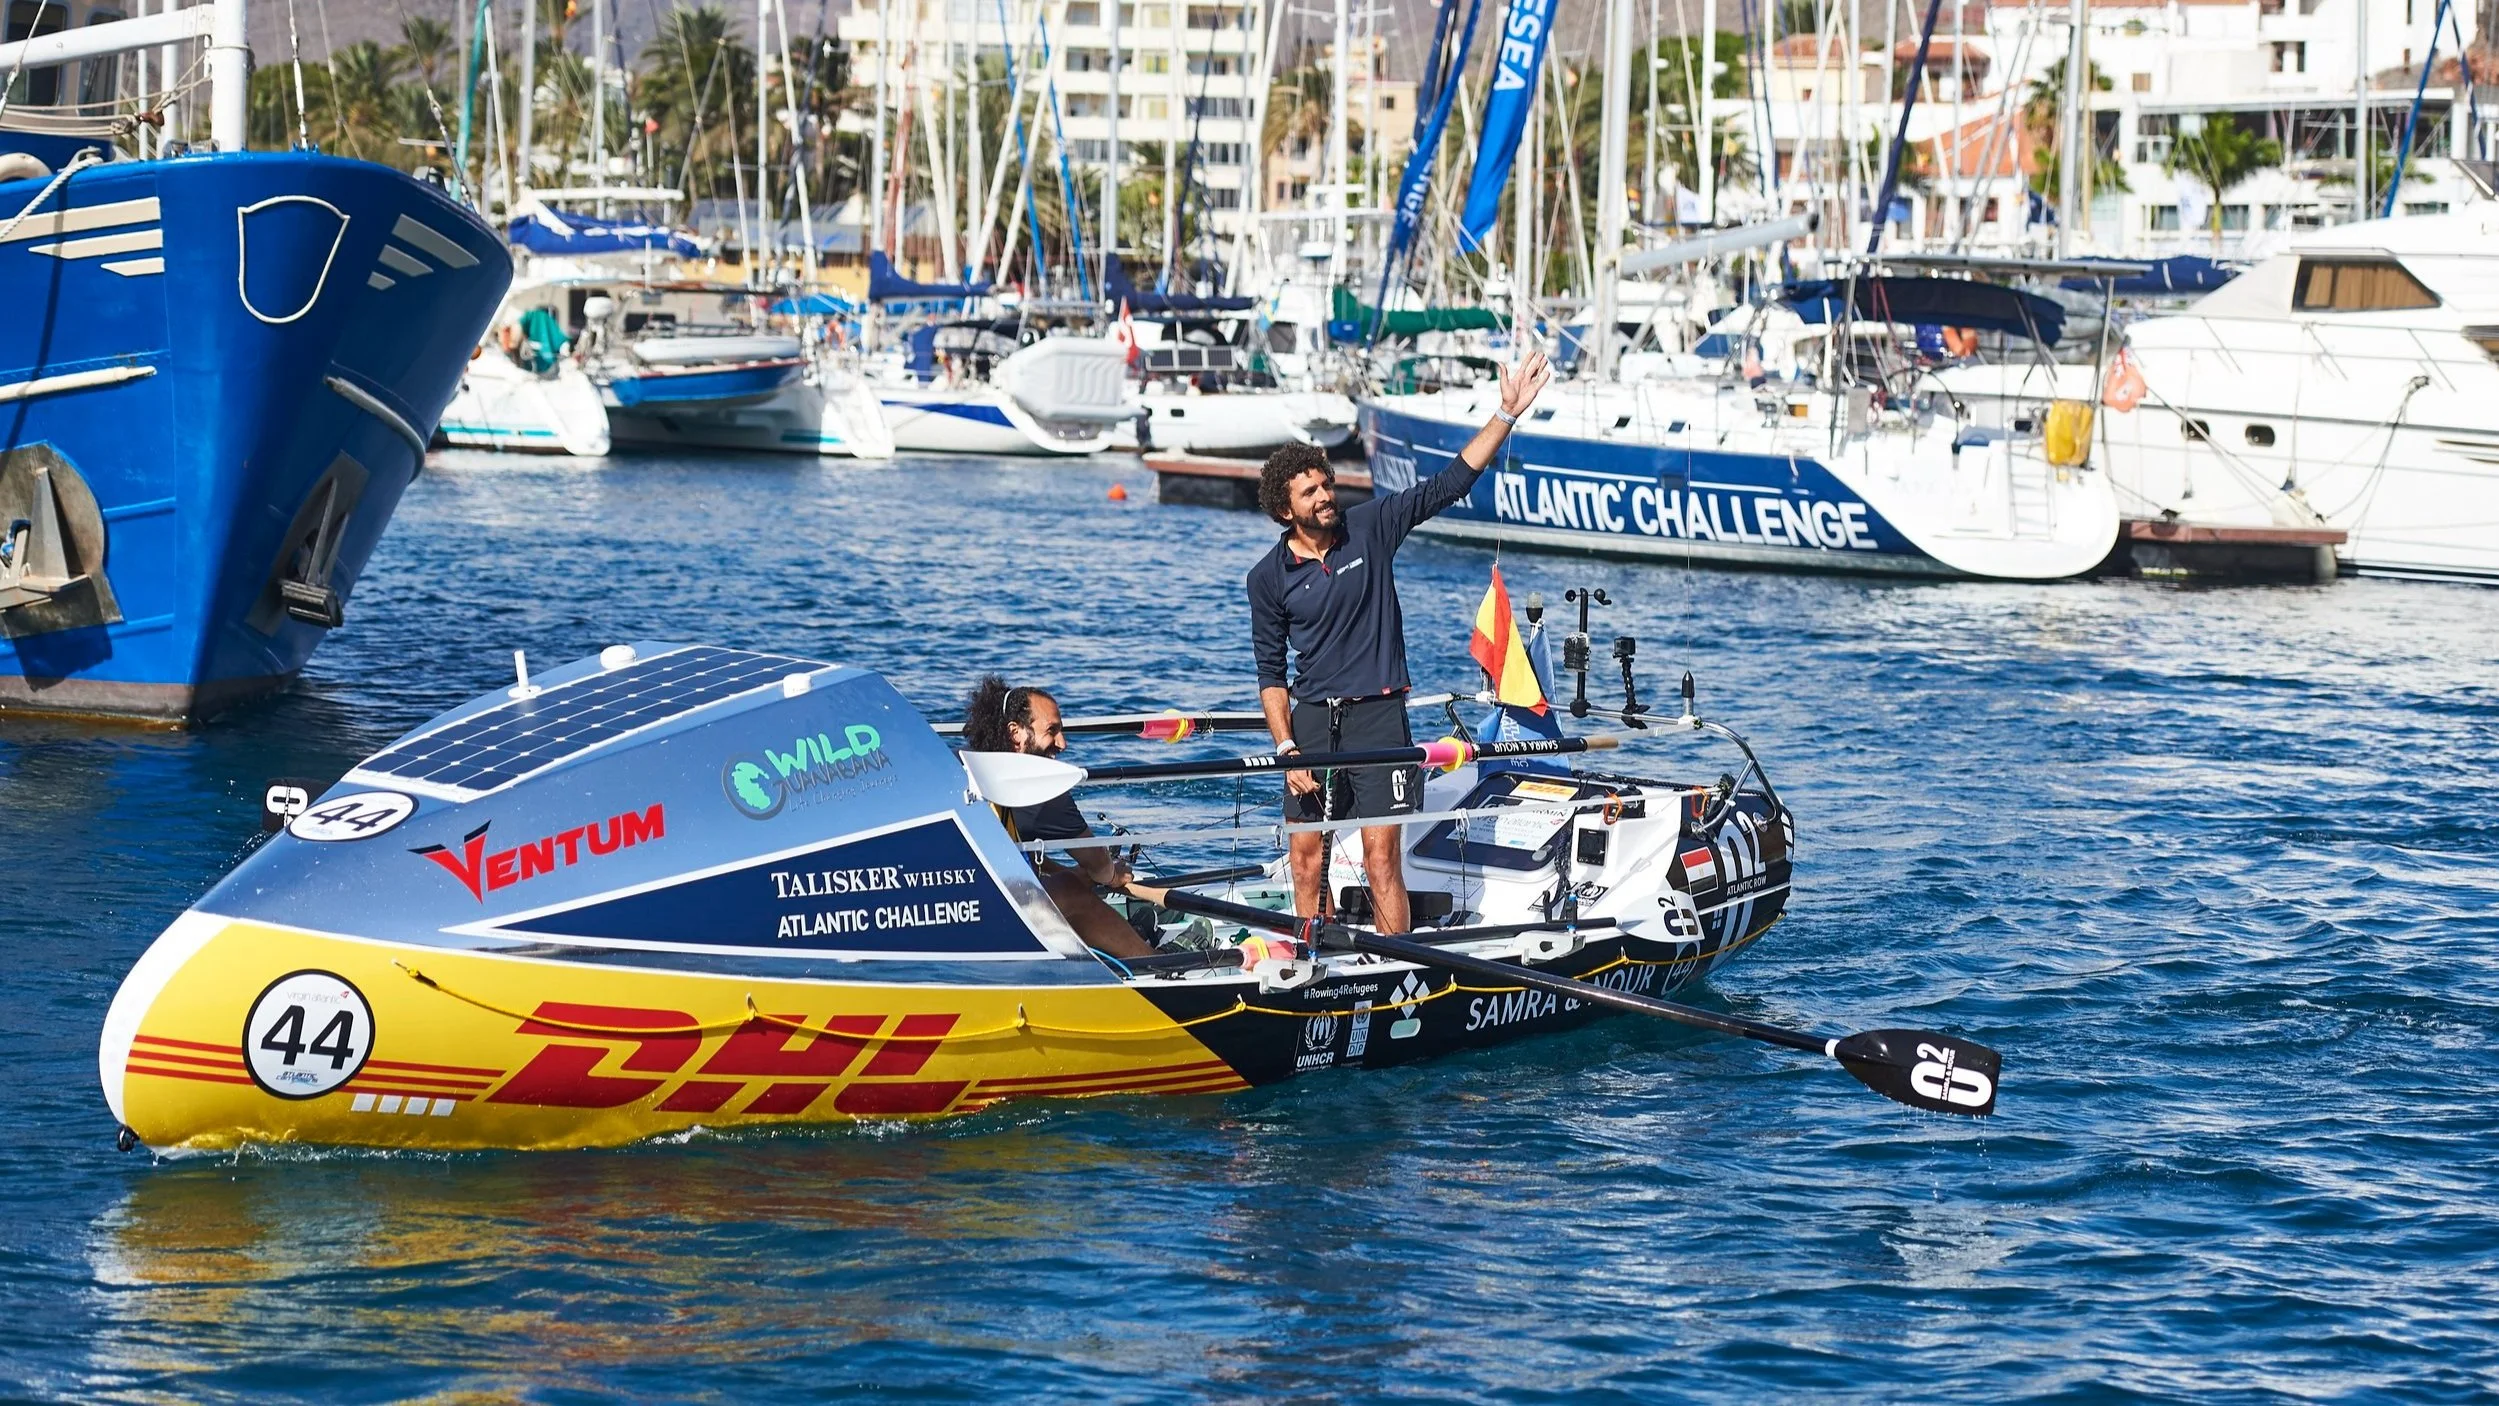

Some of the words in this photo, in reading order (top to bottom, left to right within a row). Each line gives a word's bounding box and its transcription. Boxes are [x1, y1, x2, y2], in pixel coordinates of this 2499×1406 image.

[1495, 471, 1626, 533] ATLANTIC
[1632, 485, 1879, 549] CHALLENGE
[765, 724, 881, 777] WILD
[1492, 742, 1519, 753] NOUR
[1527, 740, 1559, 752] SAMRA
[310, 803, 398, 831] 44
[407, 803, 665, 905] VENTUM
[771, 866, 901, 898] TALISKER
[903, 869, 976, 889] WHISKY
[1727, 880, 1753, 896] ATLANTIC
[1754, 875, 1767, 888] ROW
[777, 909, 869, 938] ATLANTIC
[875, 900, 980, 929] CHALLENGE
[1304, 983, 1379, 1000] #Rowing4Refugees
[1466, 988, 1557, 1031] SAMRA
[261, 1005, 354, 1070] 44
[484, 1001, 970, 1114] DHL
[1296, 1052, 1334, 1068] UNHCR
